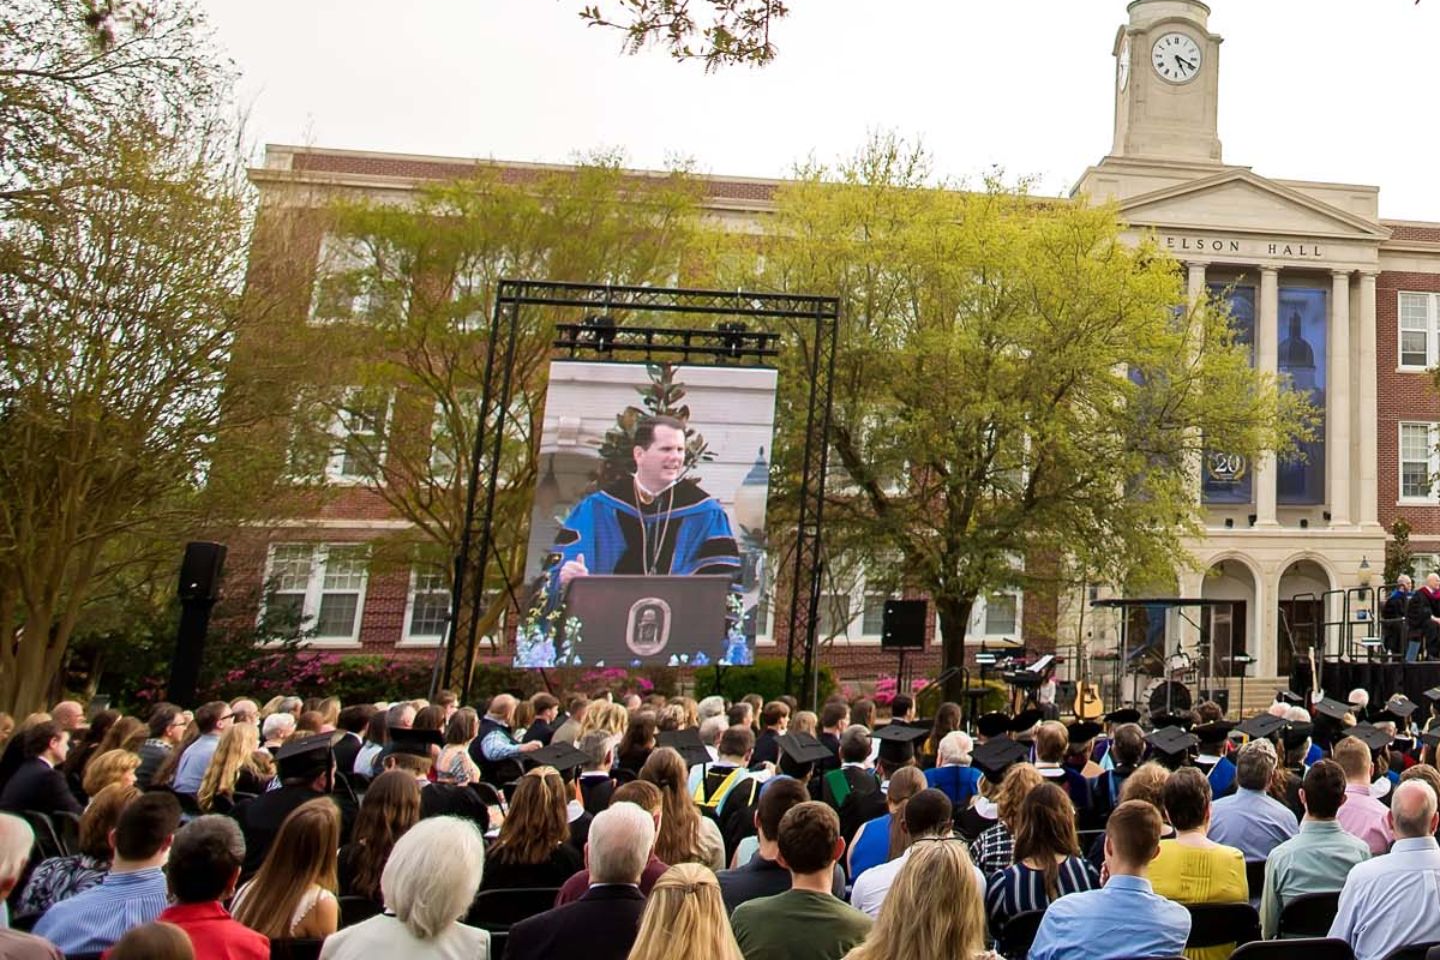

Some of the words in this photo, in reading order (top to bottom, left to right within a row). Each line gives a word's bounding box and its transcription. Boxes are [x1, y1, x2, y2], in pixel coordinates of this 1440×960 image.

[1151, 236, 1239, 251] ELSON
[1267, 244, 1321, 257] HALL
[1215, 453, 1241, 473] 20
